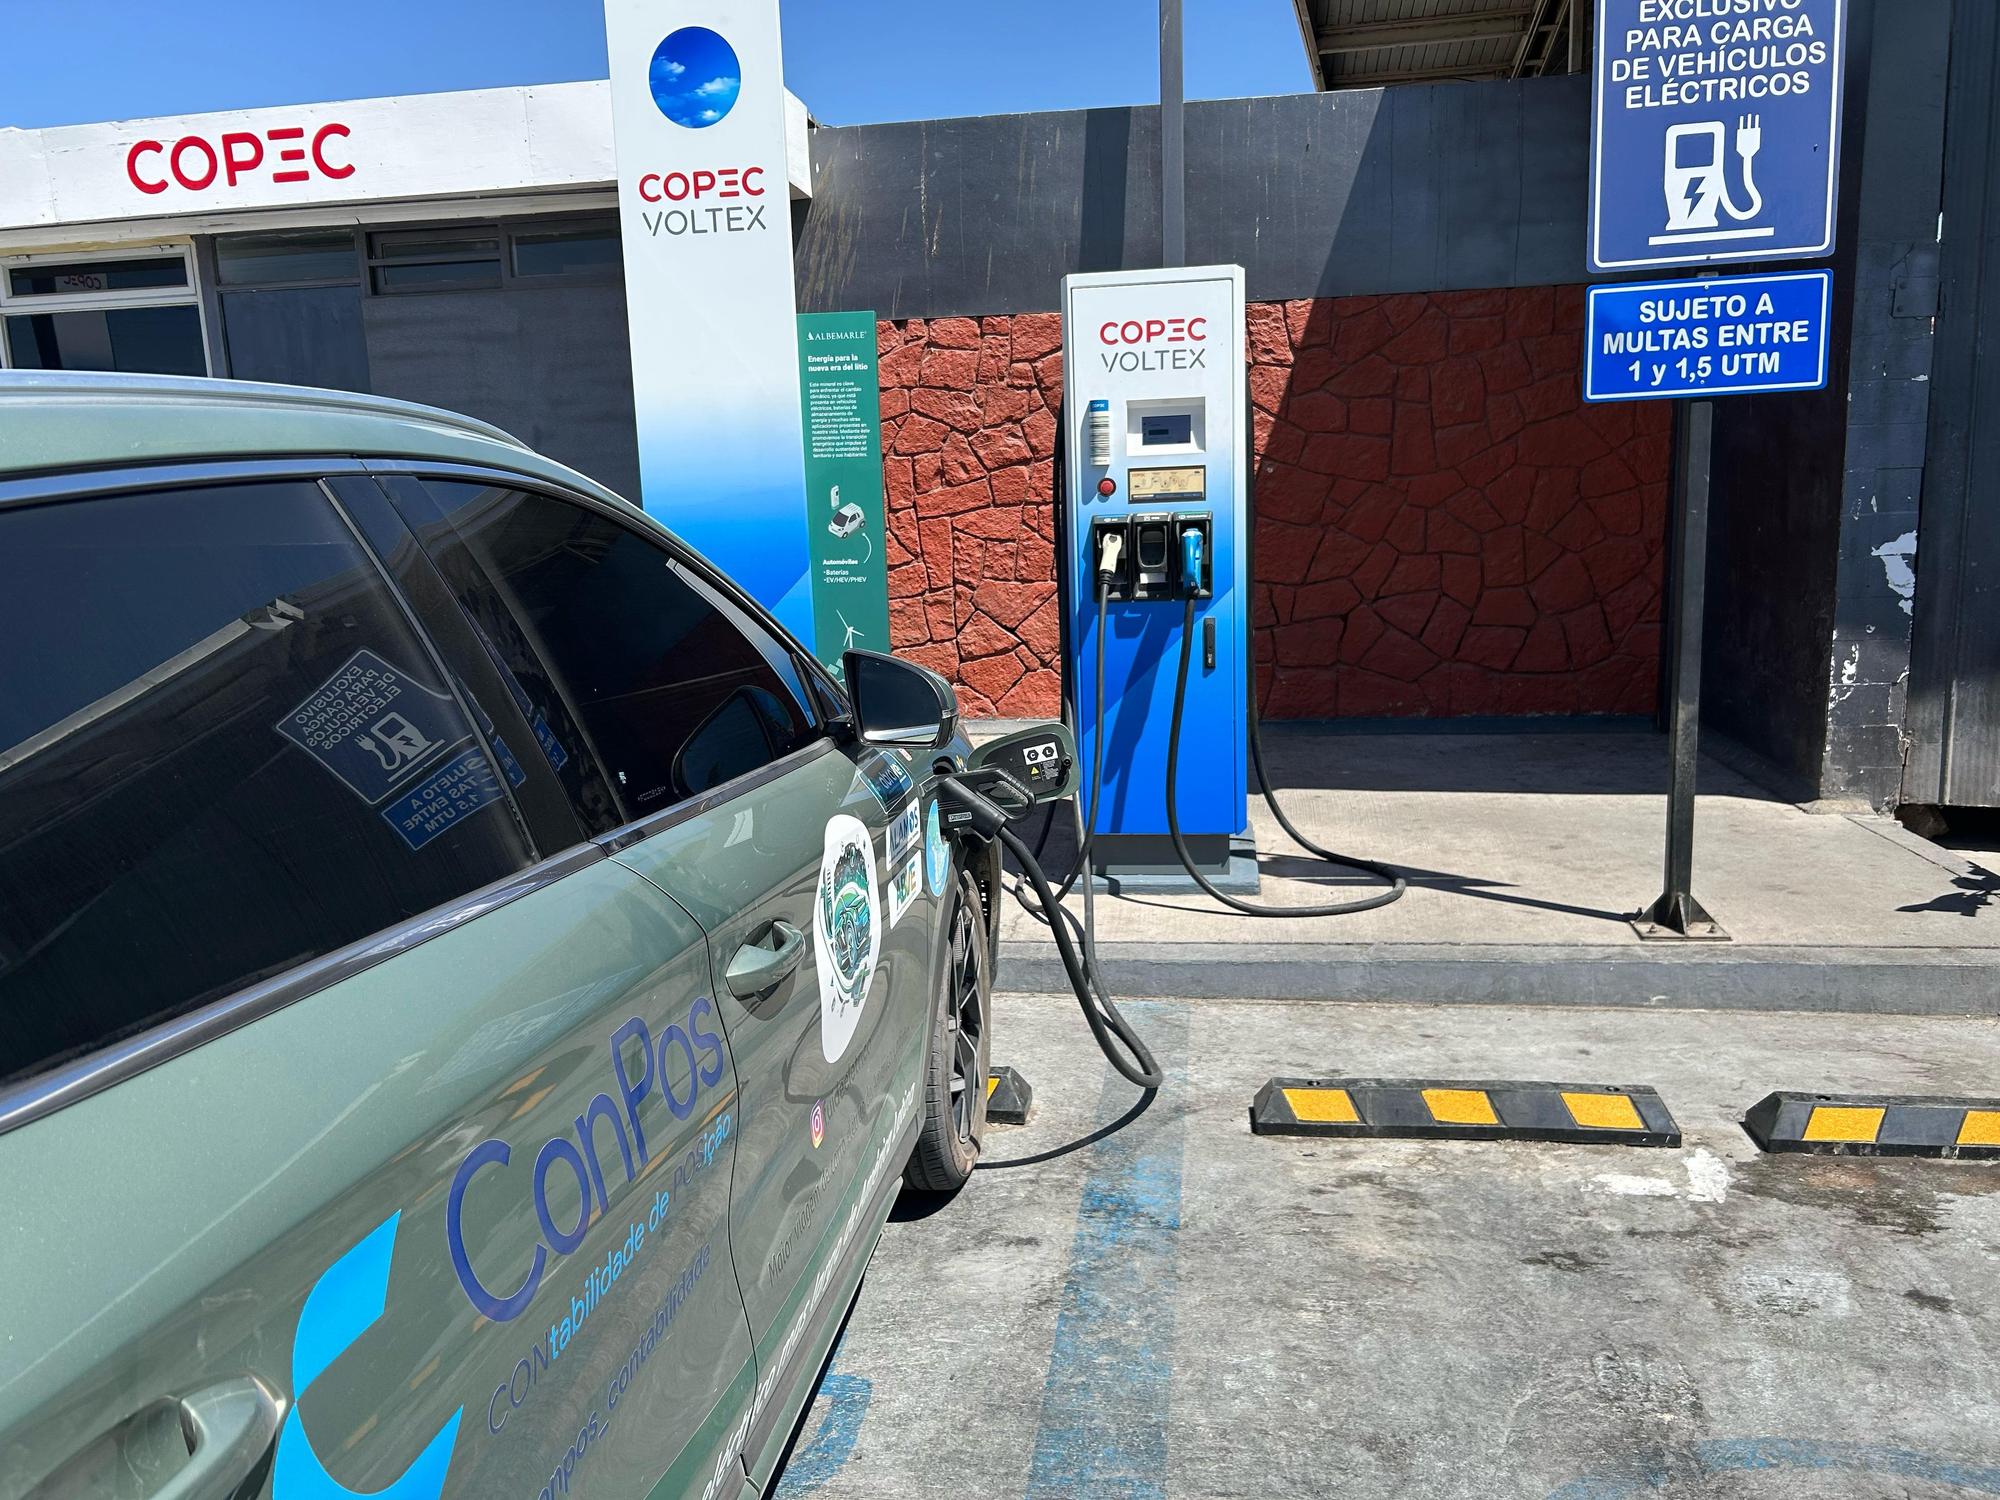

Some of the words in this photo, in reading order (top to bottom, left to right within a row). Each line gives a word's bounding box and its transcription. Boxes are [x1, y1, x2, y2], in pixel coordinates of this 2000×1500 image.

[1626, 25, 1702, 53] PARA
[1710, 14, 1813, 45] CARGA
[1611, 57, 1650, 82] DE
[1657, 41, 1826, 79] VEHÍCULOS
[1625, 71, 1810, 109] ELÉCTRICOS
[127, 123, 356, 194] COPEC
[639, 167, 765, 203] COPEC
[642, 205, 767, 236] VOLTEX
[1639, 295, 1747, 323] SUJETO
[1754, 293, 1774, 316] A
[1099, 317, 1208, 346] COPEC
[1603, 325, 1709, 355] MULTAS
[1718, 320, 1809, 348] ENTRE
[807, 354, 834, 363] Energía
[851, 353, 859, 361] la
[842, 363, 854, 371] del
[854, 362, 869, 370] litio
[1101, 347, 1206, 373] VOLTEX
[1628, 361, 1640, 382] 1
[1650, 365, 1667, 387] y
[1675, 354, 1712, 385] 1,5
[1721, 352, 1780, 377] UTM
[445, 996, 724, 1322] ConPos
[768, 1230, 793, 1287] Maior
[793, 1184, 820, 1229] viagem
[487, 1222, 645, 1435] CONtabilidade
[648, 1191, 669, 1232] de
